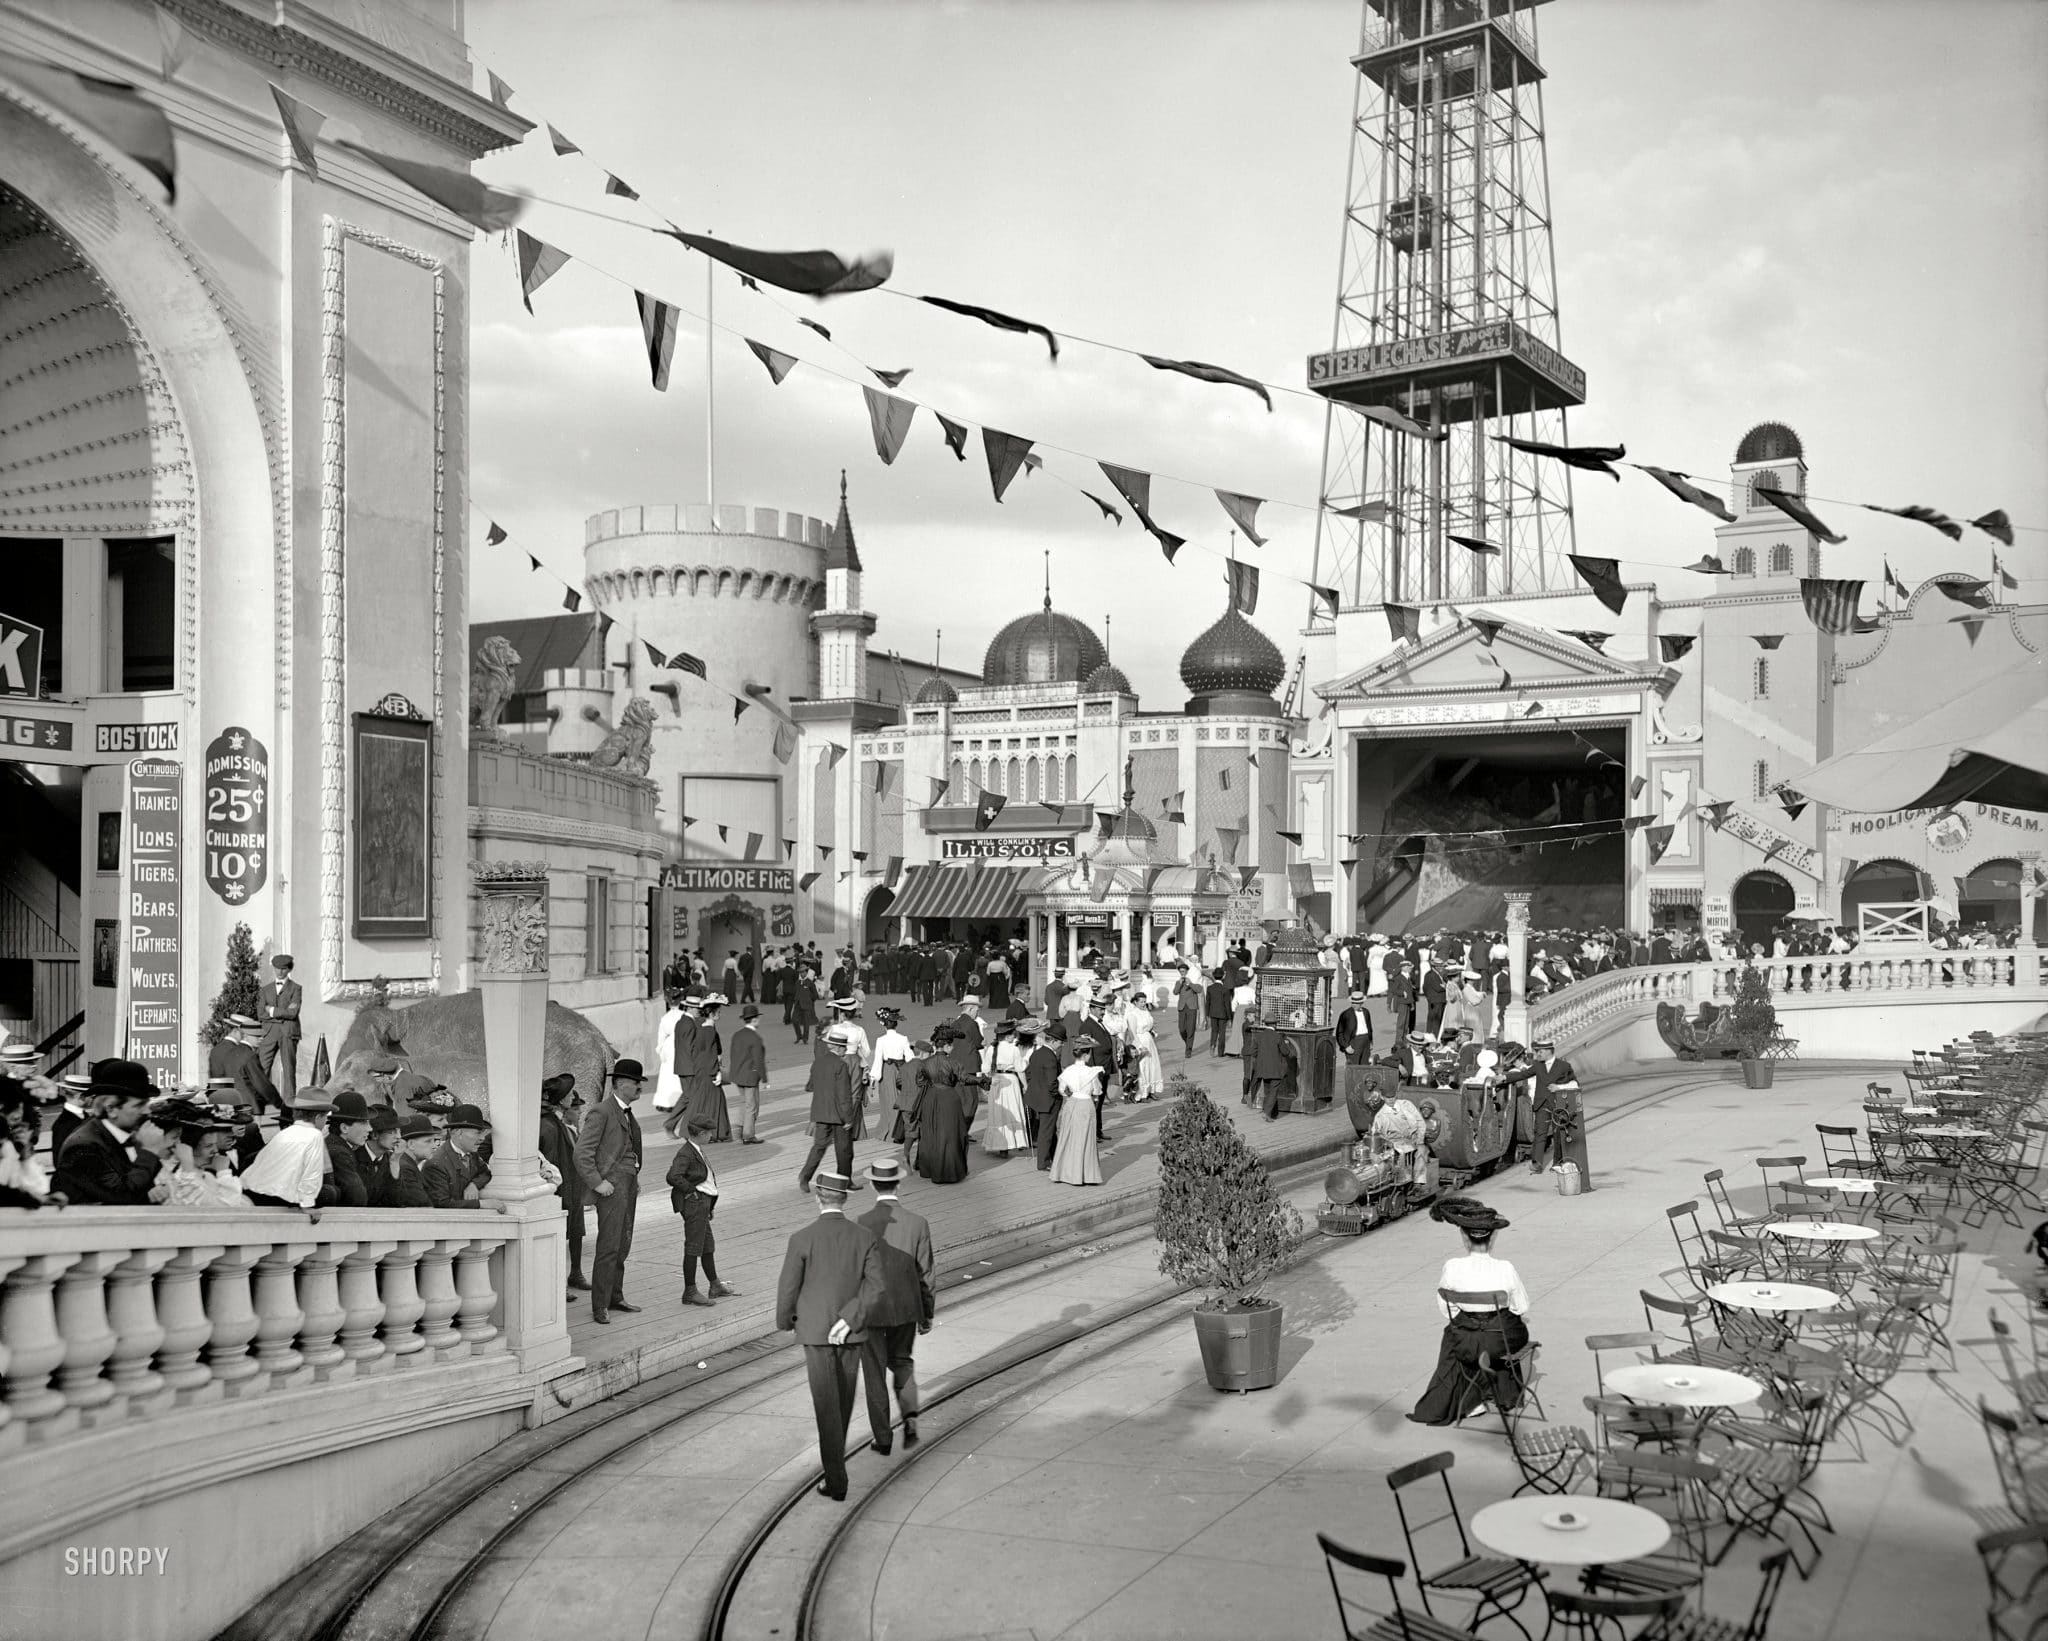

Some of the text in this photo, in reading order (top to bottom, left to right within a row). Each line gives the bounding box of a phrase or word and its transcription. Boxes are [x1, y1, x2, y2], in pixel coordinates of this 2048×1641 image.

[1313, 334, 1450, 379] STEEPLECHASE
[1371, 697, 1600, 725] GENERAL BMPS
[98, 725, 177, 750] BOSTOCK
[131, 760, 180, 777] CONTINUOUS
[207, 755, 267, 781] ADMISSION
[132, 786, 178, 811] TRAINED
[208, 784, 264, 822] 25¢
[206, 829, 265, 848] CHILDREN
[209, 850, 261, 879] 10¢
[662, 869, 792, 889] ALTIMORE FIRE
[1706, 904, 1728, 912] TEMPLE
[1706, 917, 1728, 926] MIRTH
[131, 1038, 177, 1059] HYENAS
